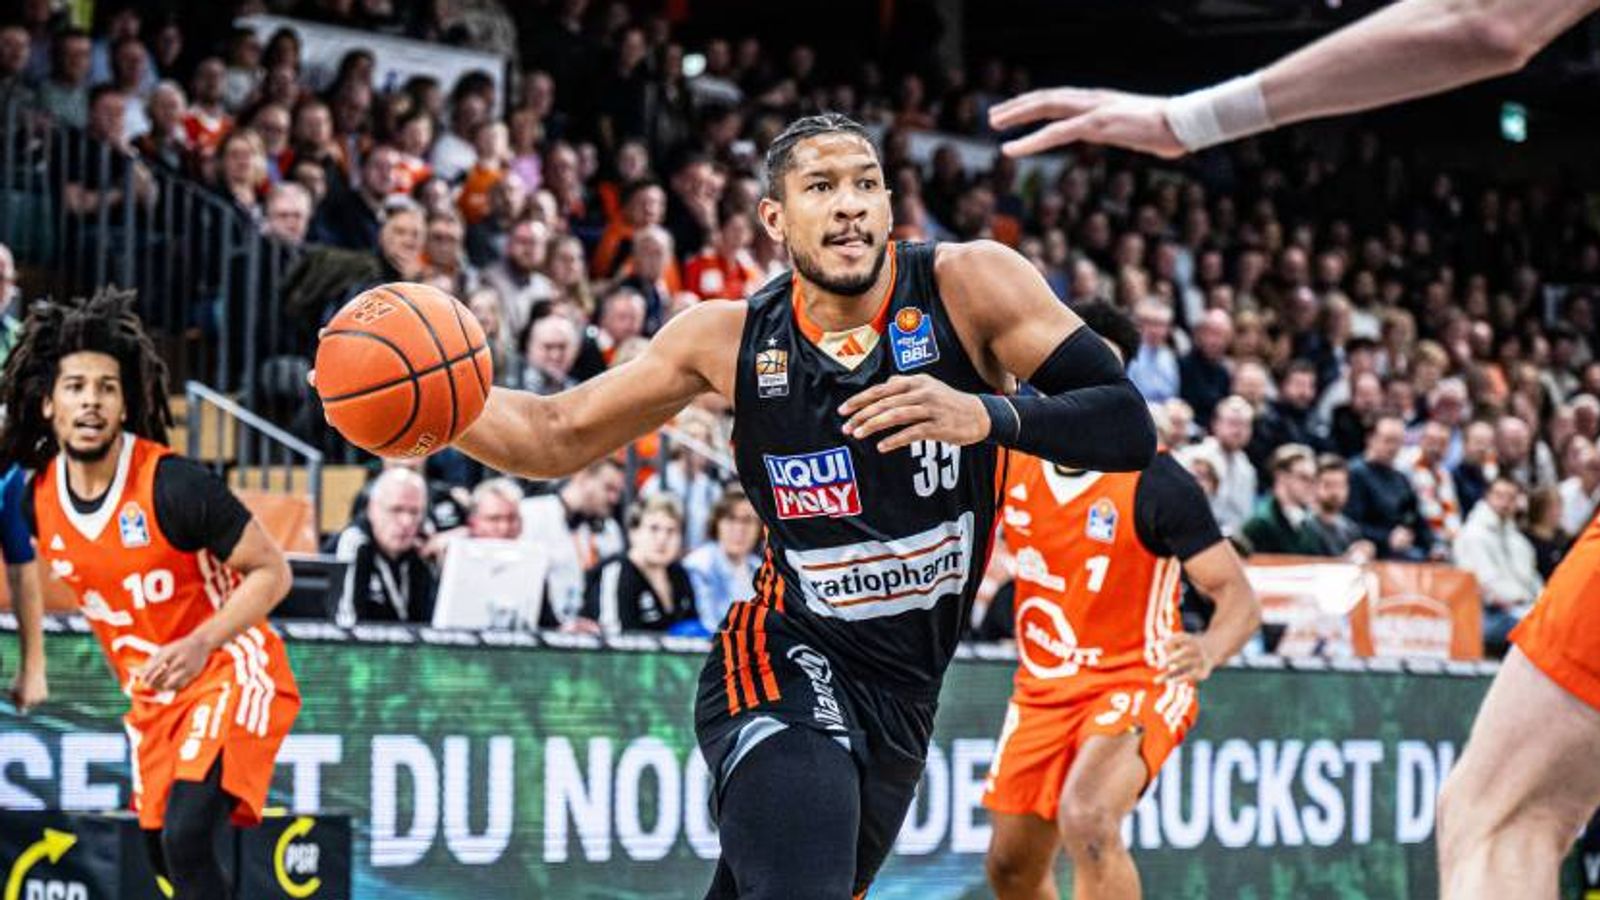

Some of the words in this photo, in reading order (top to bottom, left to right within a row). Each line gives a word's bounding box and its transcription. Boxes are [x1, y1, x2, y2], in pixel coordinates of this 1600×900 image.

[901, 344, 933, 364] BBL
[768, 452, 848, 487] LIQUI
[911, 440, 961, 497] 35
[778, 483, 853, 515] MOLY
[123, 568, 175, 610] 10
[1085, 554, 1110, 593] 1
[371, 735, 514, 866] DU
[894, 738, 998, 855] DE
[1119, 738, 1384, 849] UCKST
[285, 843, 320, 875] PSR
